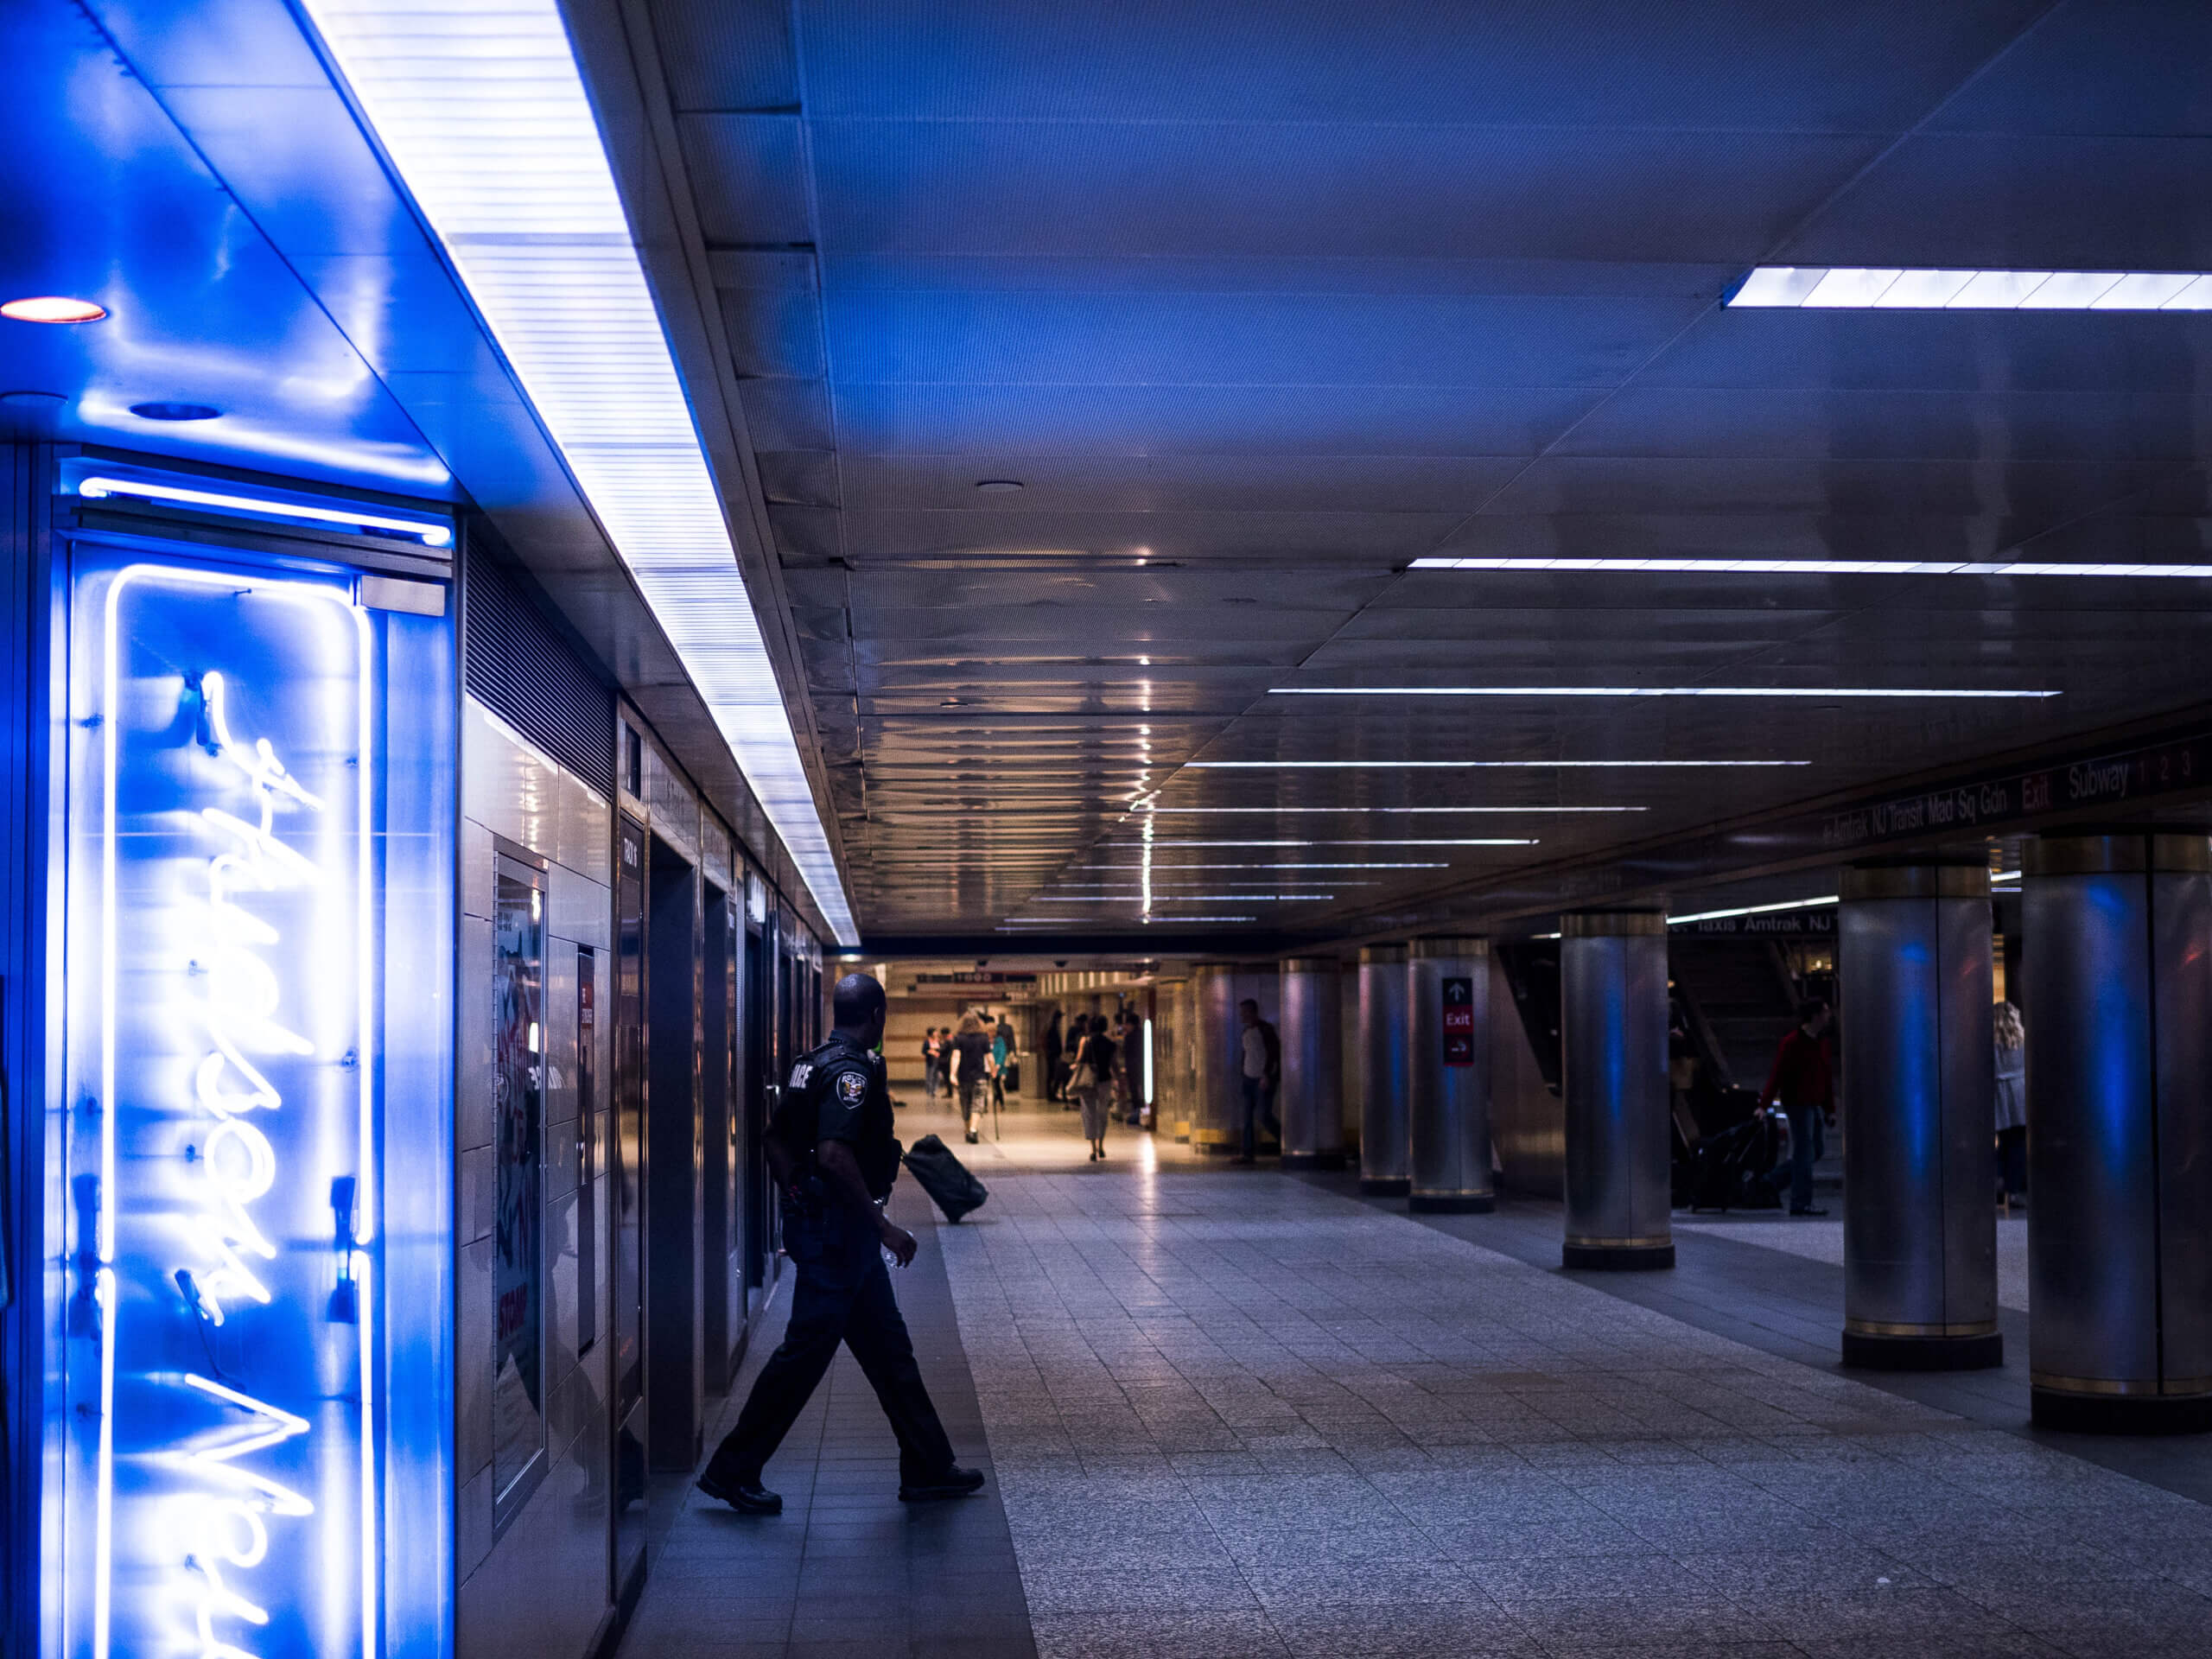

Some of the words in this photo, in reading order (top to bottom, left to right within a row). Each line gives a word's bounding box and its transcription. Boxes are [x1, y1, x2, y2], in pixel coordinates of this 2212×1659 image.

[1872, 809, 1887, 835] NJ
[1890, 803, 1923, 830] Transit
[1928, 791, 1955, 823] Mad
[1958, 789, 1976, 824] Sq
[1980, 785, 2007, 815] Gdn
[2022, 776, 2050, 810] Exit
[2069, 761, 2129, 799] Subway
[2159, 757, 2169, 779] 2
[2182, 751, 2191, 776] 3
[1745, 915, 1803, 932] Amtrak
[1808, 913, 1831, 931] NJ
[195, 670, 325, 1325] Hudson
[1446, 1012, 1471, 1027] Exit
